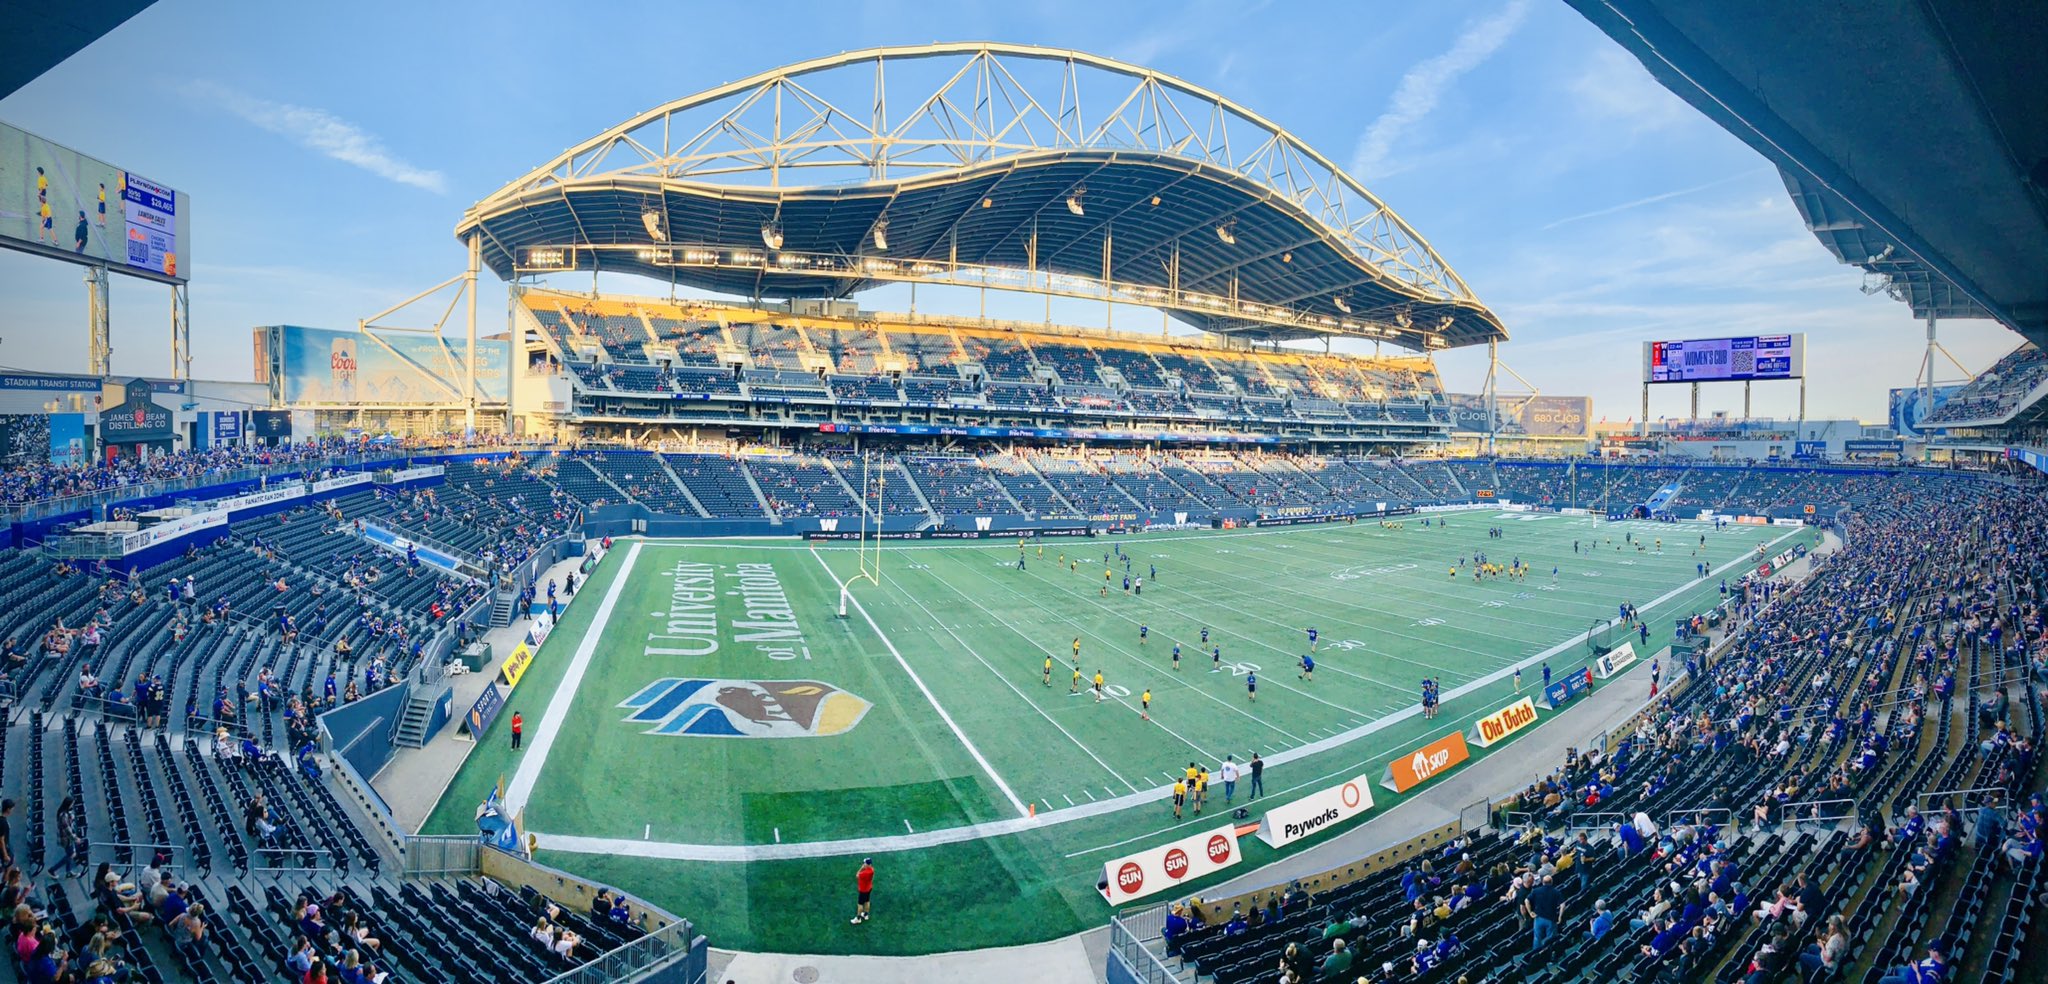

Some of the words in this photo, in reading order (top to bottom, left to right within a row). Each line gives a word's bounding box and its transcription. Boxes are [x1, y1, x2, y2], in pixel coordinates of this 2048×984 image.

[1684, 350, 1713, 366] WOMEN'S
[4, 378, 39, 387] STADIUM
[40, 379, 69, 388] TRANSIT
[69, 381, 97, 389] STATION
[108, 413, 134, 422] JAMES
[145, 412, 166, 421] BEAM
[154, 420, 166, 428] CO
[1460, 411, 1487, 422] CJOB
[1533, 413, 1551, 424] 680
[1554, 413, 1581, 424] CJOB
[1801, 443, 1814, 455] W
[245, 496, 264, 505] FANATIC
[273, 491, 285, 500] ZONE
[974, 516, 993, 531] W
[1119, 513, 1137, 521] FANS
[1174, 512, 1188, 525] W
[819, 518, 839, 532] W
[125, 534, 139, 553] PARTY
[643, 560, 727, 657] University
[724, 562, 806, 644] Manitoba
[755, 644, 797, 661] of
[1602, 657, 1614, 674] IG
[476, 687, 494, 713] SPORTS
[1551, 688, 1565, 699] Global
[1481, 718, 1504, 742] Old
[1502, 700, 1534, 732] Dutch
[1429, 748, 1449, 772] SKIP
[1284, 807, 1339, 839] Payworks
[1209, 841, 1229, 857] SUN
[1166, 856, 1187, 872] SUN
[1119, 871, 1142, 886] SUN
